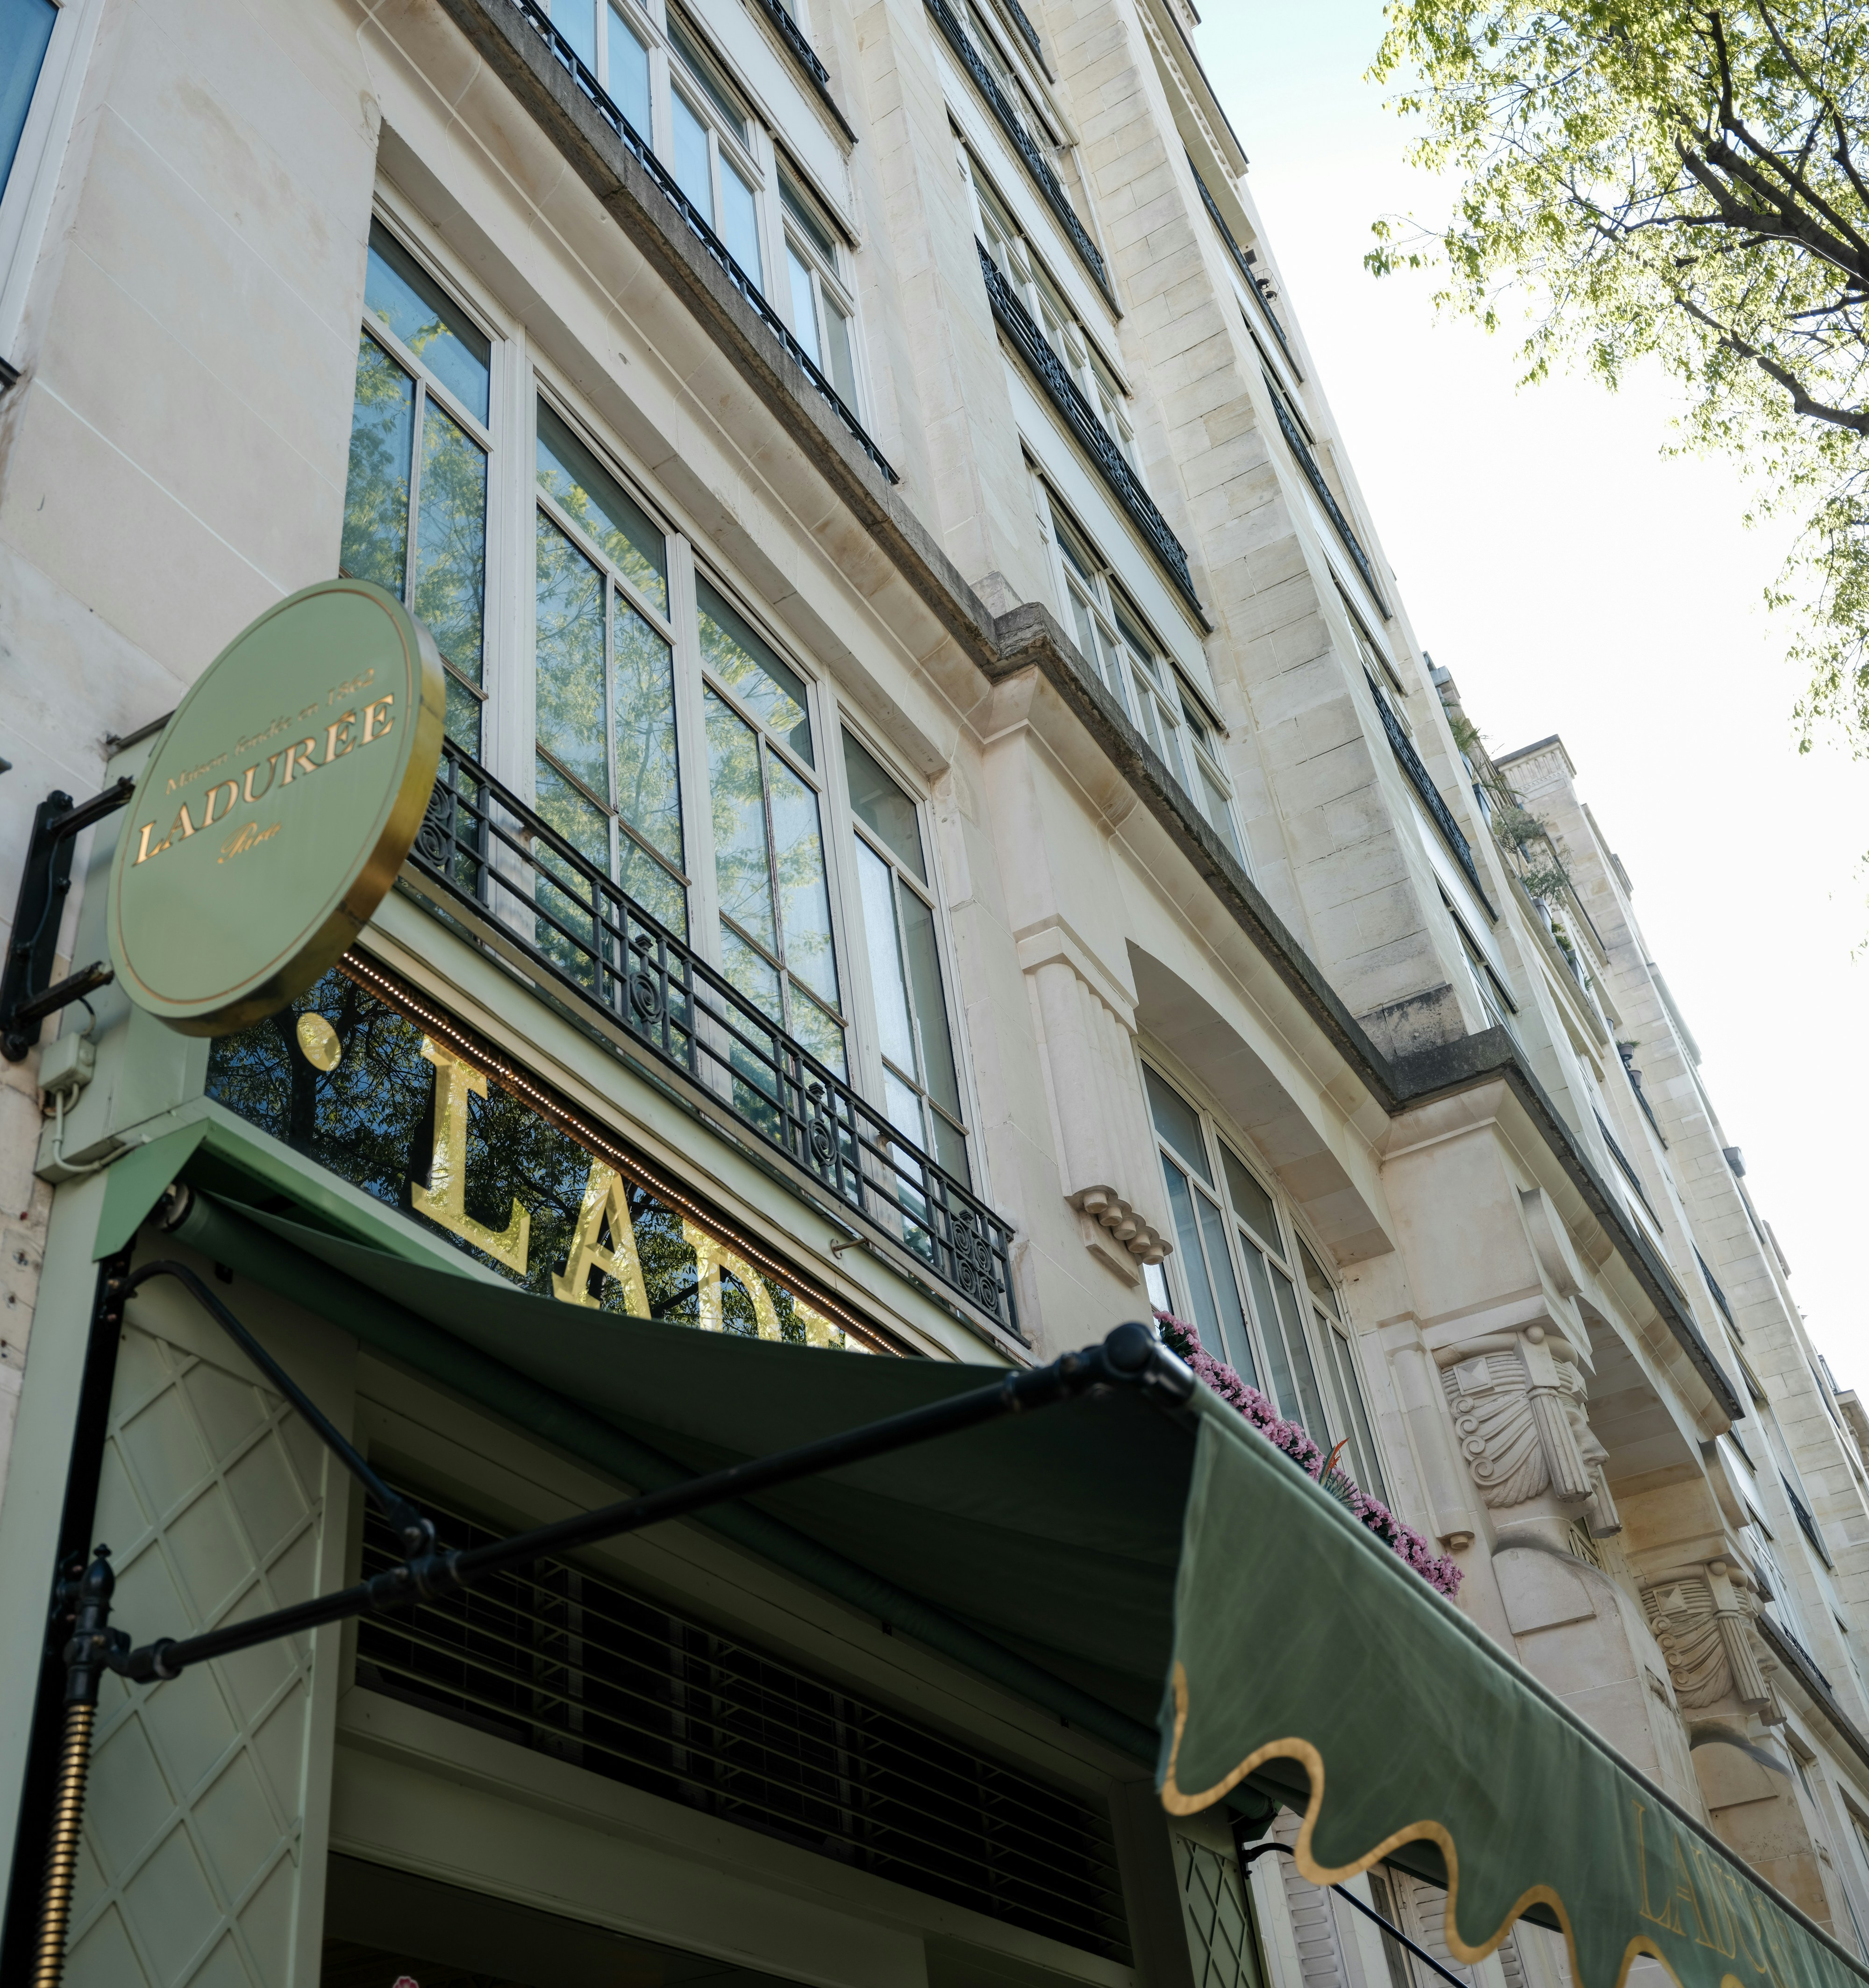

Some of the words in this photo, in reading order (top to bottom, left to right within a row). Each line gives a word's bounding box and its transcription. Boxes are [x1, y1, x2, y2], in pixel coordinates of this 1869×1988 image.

[132, 692, 395, 867] LADURÉE
[165, 751, 228, 795] Maison
[233, 715, 292, 757] fondée
[298, 702, 318, 721] en
[326, 667, 374, 707] 1862
[217, 820, 281, 864] Paris
